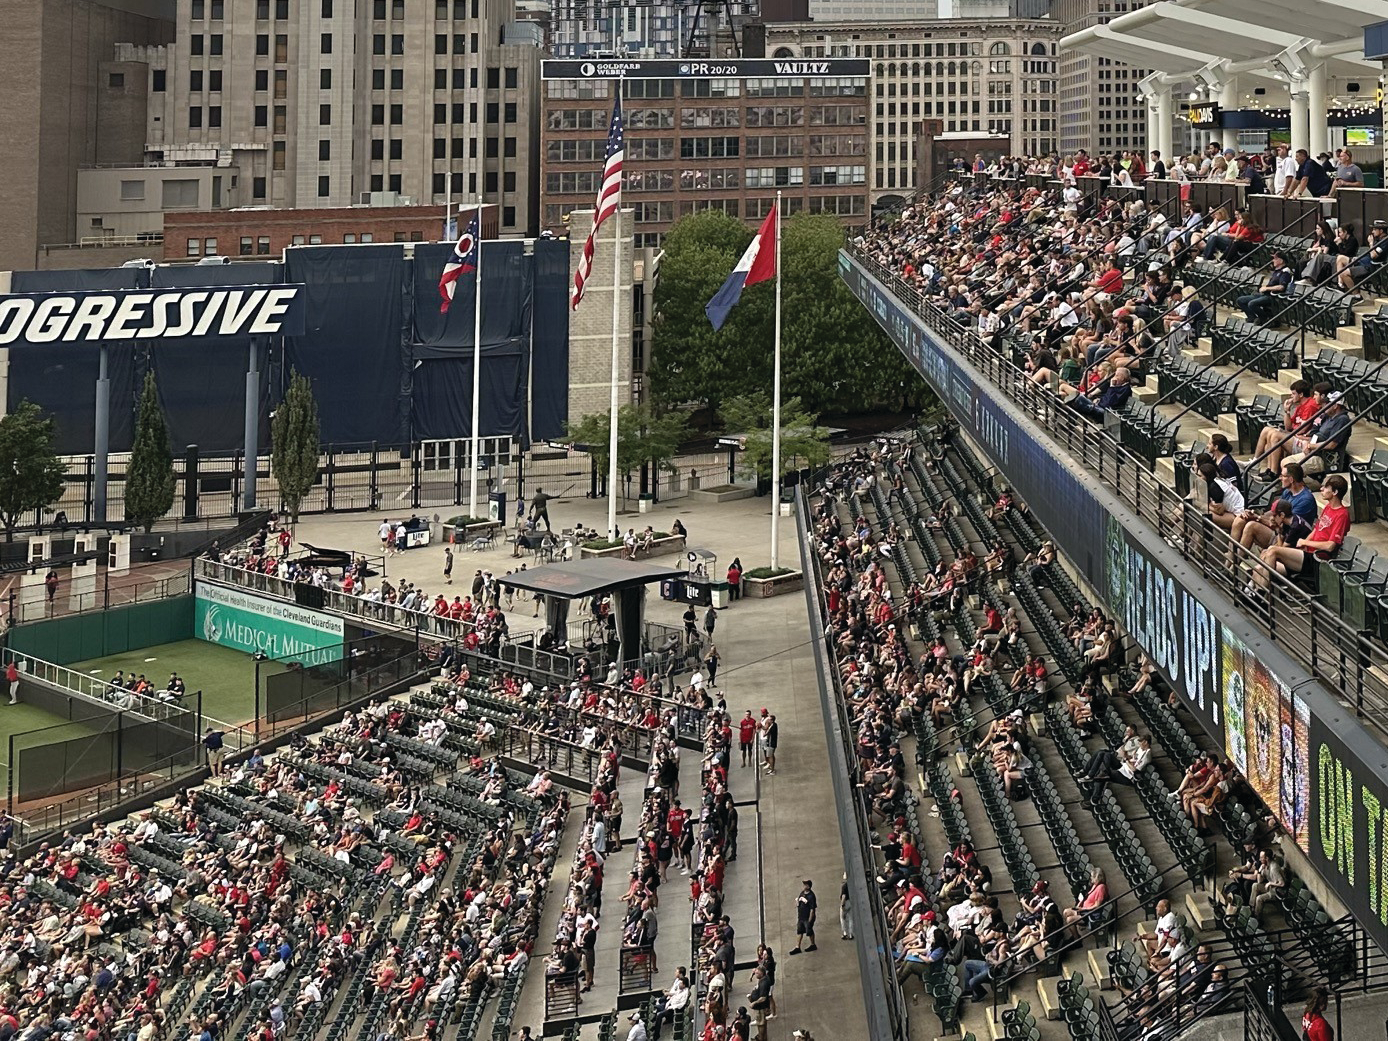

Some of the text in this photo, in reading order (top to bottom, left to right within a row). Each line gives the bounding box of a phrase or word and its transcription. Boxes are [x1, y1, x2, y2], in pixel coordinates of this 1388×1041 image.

[691, 63, 738, 75] PR 20/20
[774, 62, 829, 74] VAULTZ
[686, 585, 699, 599] Lite
[282, 608, 310, 624] Cleveland
[311, 615, 342, 633] Guardians
[225, 618, 279, 654] MEDICAL
[1124, 542, 1220, 726] HEADS UP!
[1318, 742, 1355, 887] ON
